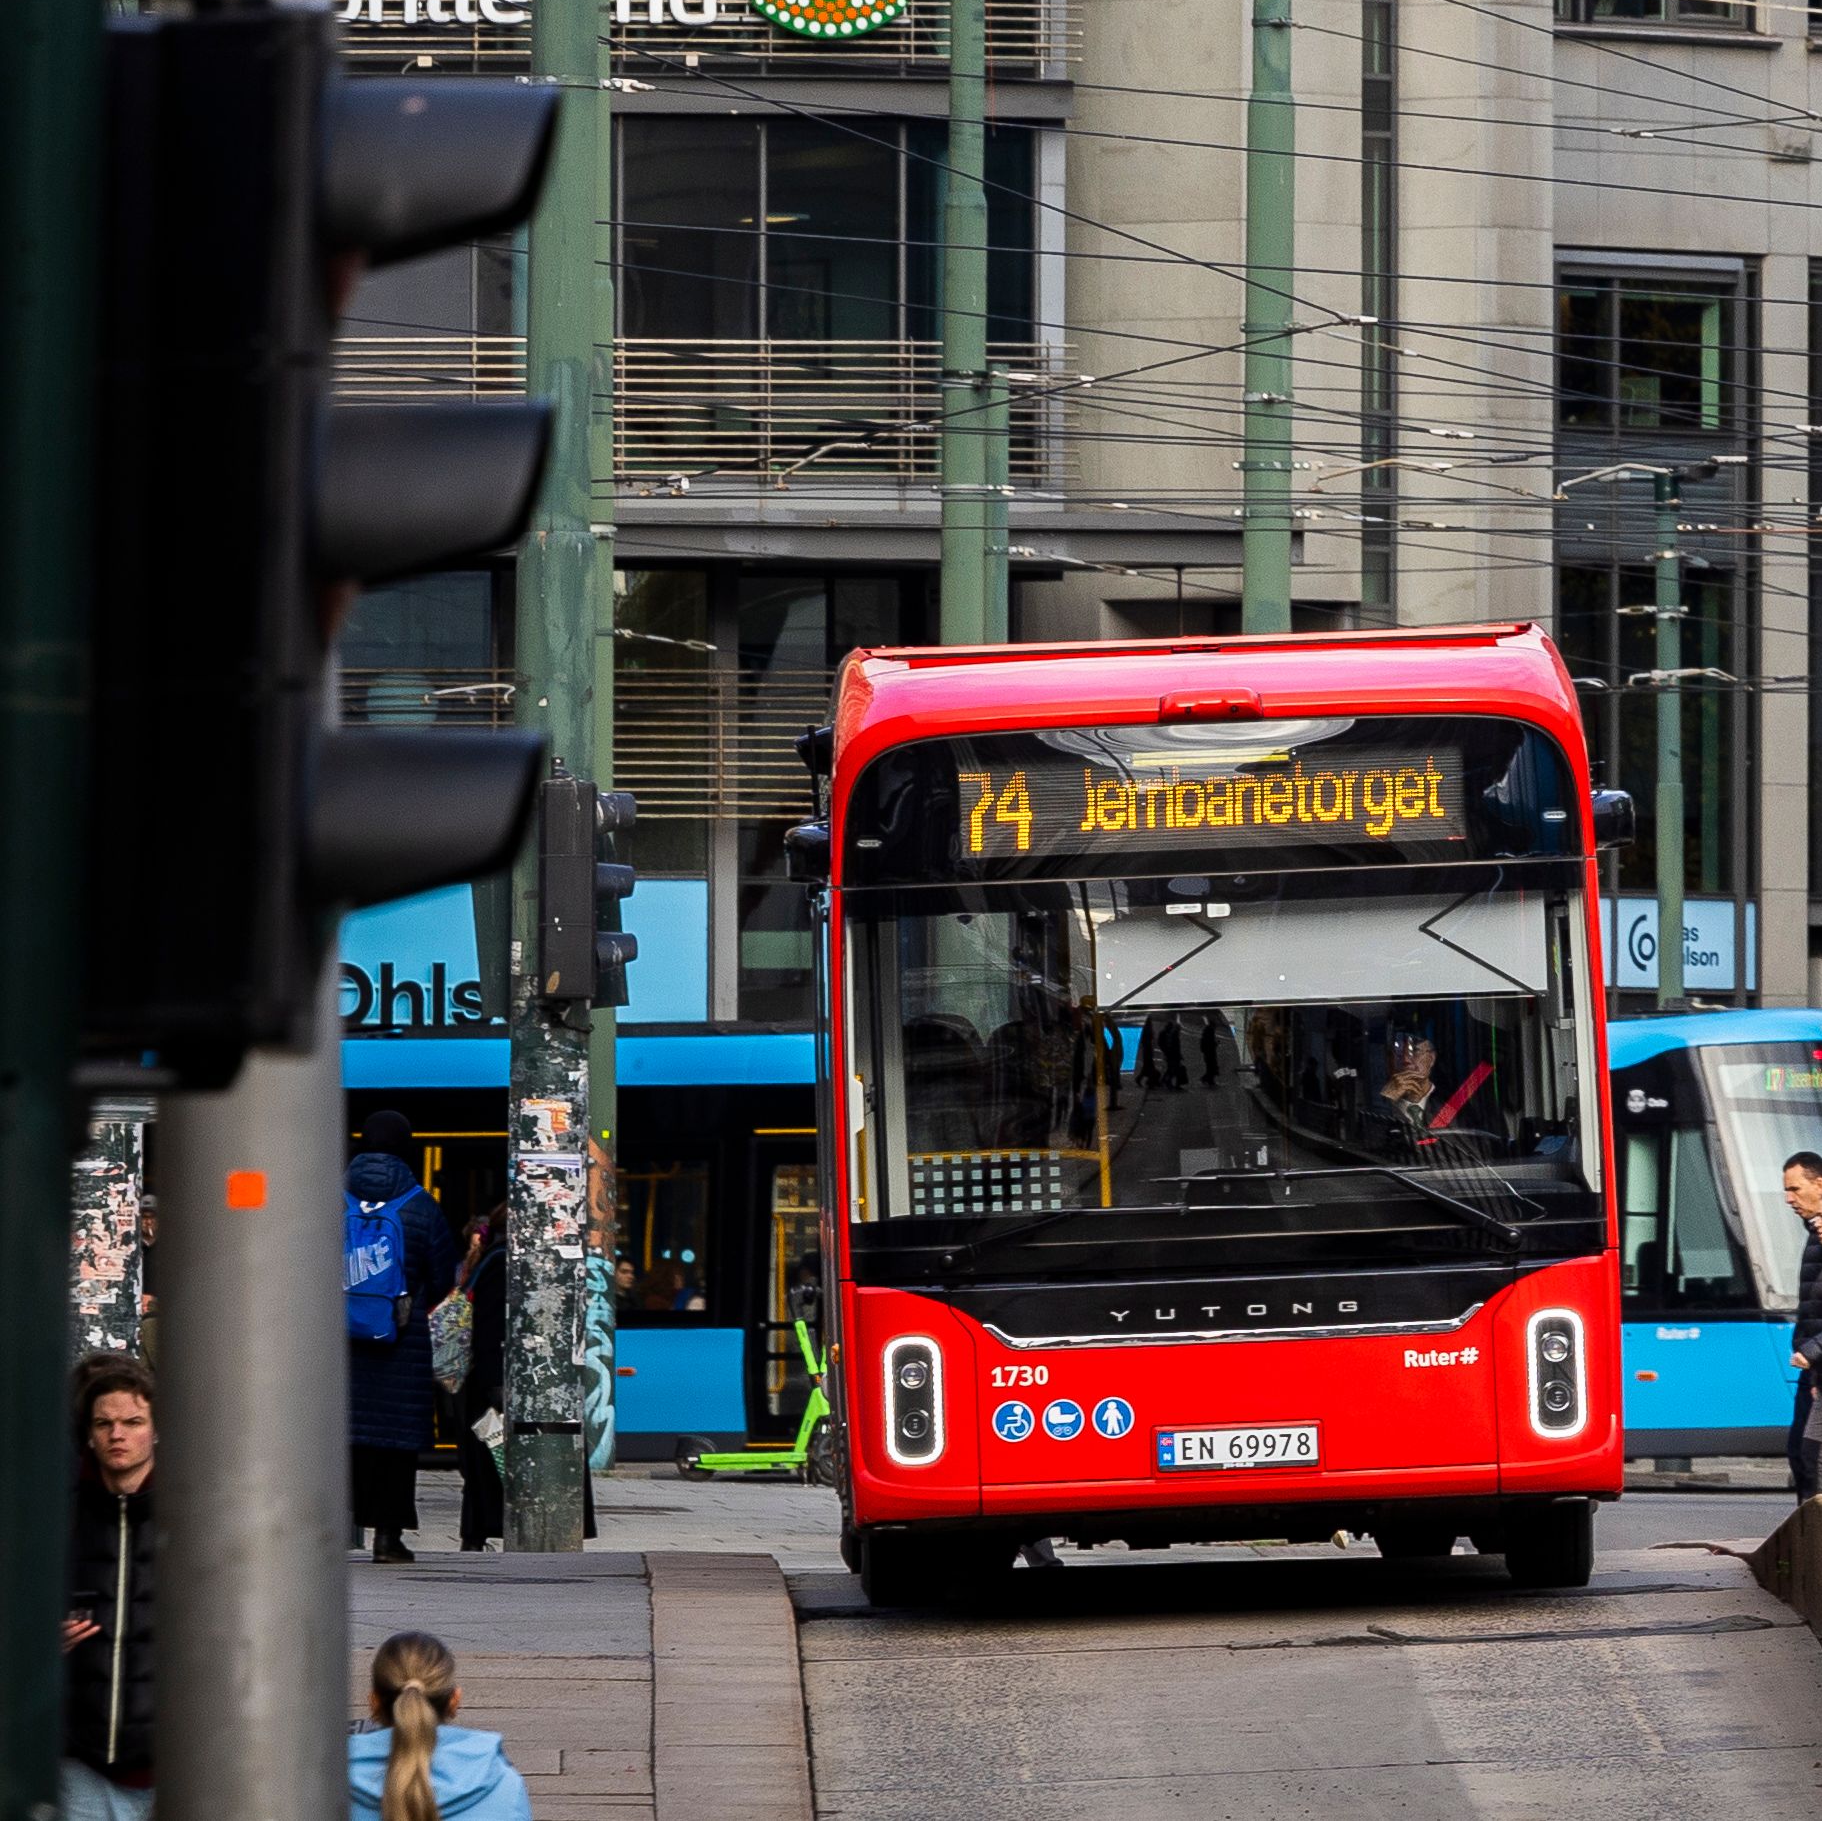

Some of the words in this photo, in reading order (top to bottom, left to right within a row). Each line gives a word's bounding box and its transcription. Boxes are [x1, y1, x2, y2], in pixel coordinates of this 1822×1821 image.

[958, 771, 1033, 852] 74
[1080, 755, 1445, 837] Jernbanetorget
[1110, 1300, 1359, 1323] YUTONG
[1404, 1346, 1479, 1369] Ruter#
[990, 1365, 1049, 1387] 1730
[1182, 1437, 1214, 1461] EN
[1229, 1432, 1311, 1459] 69978
